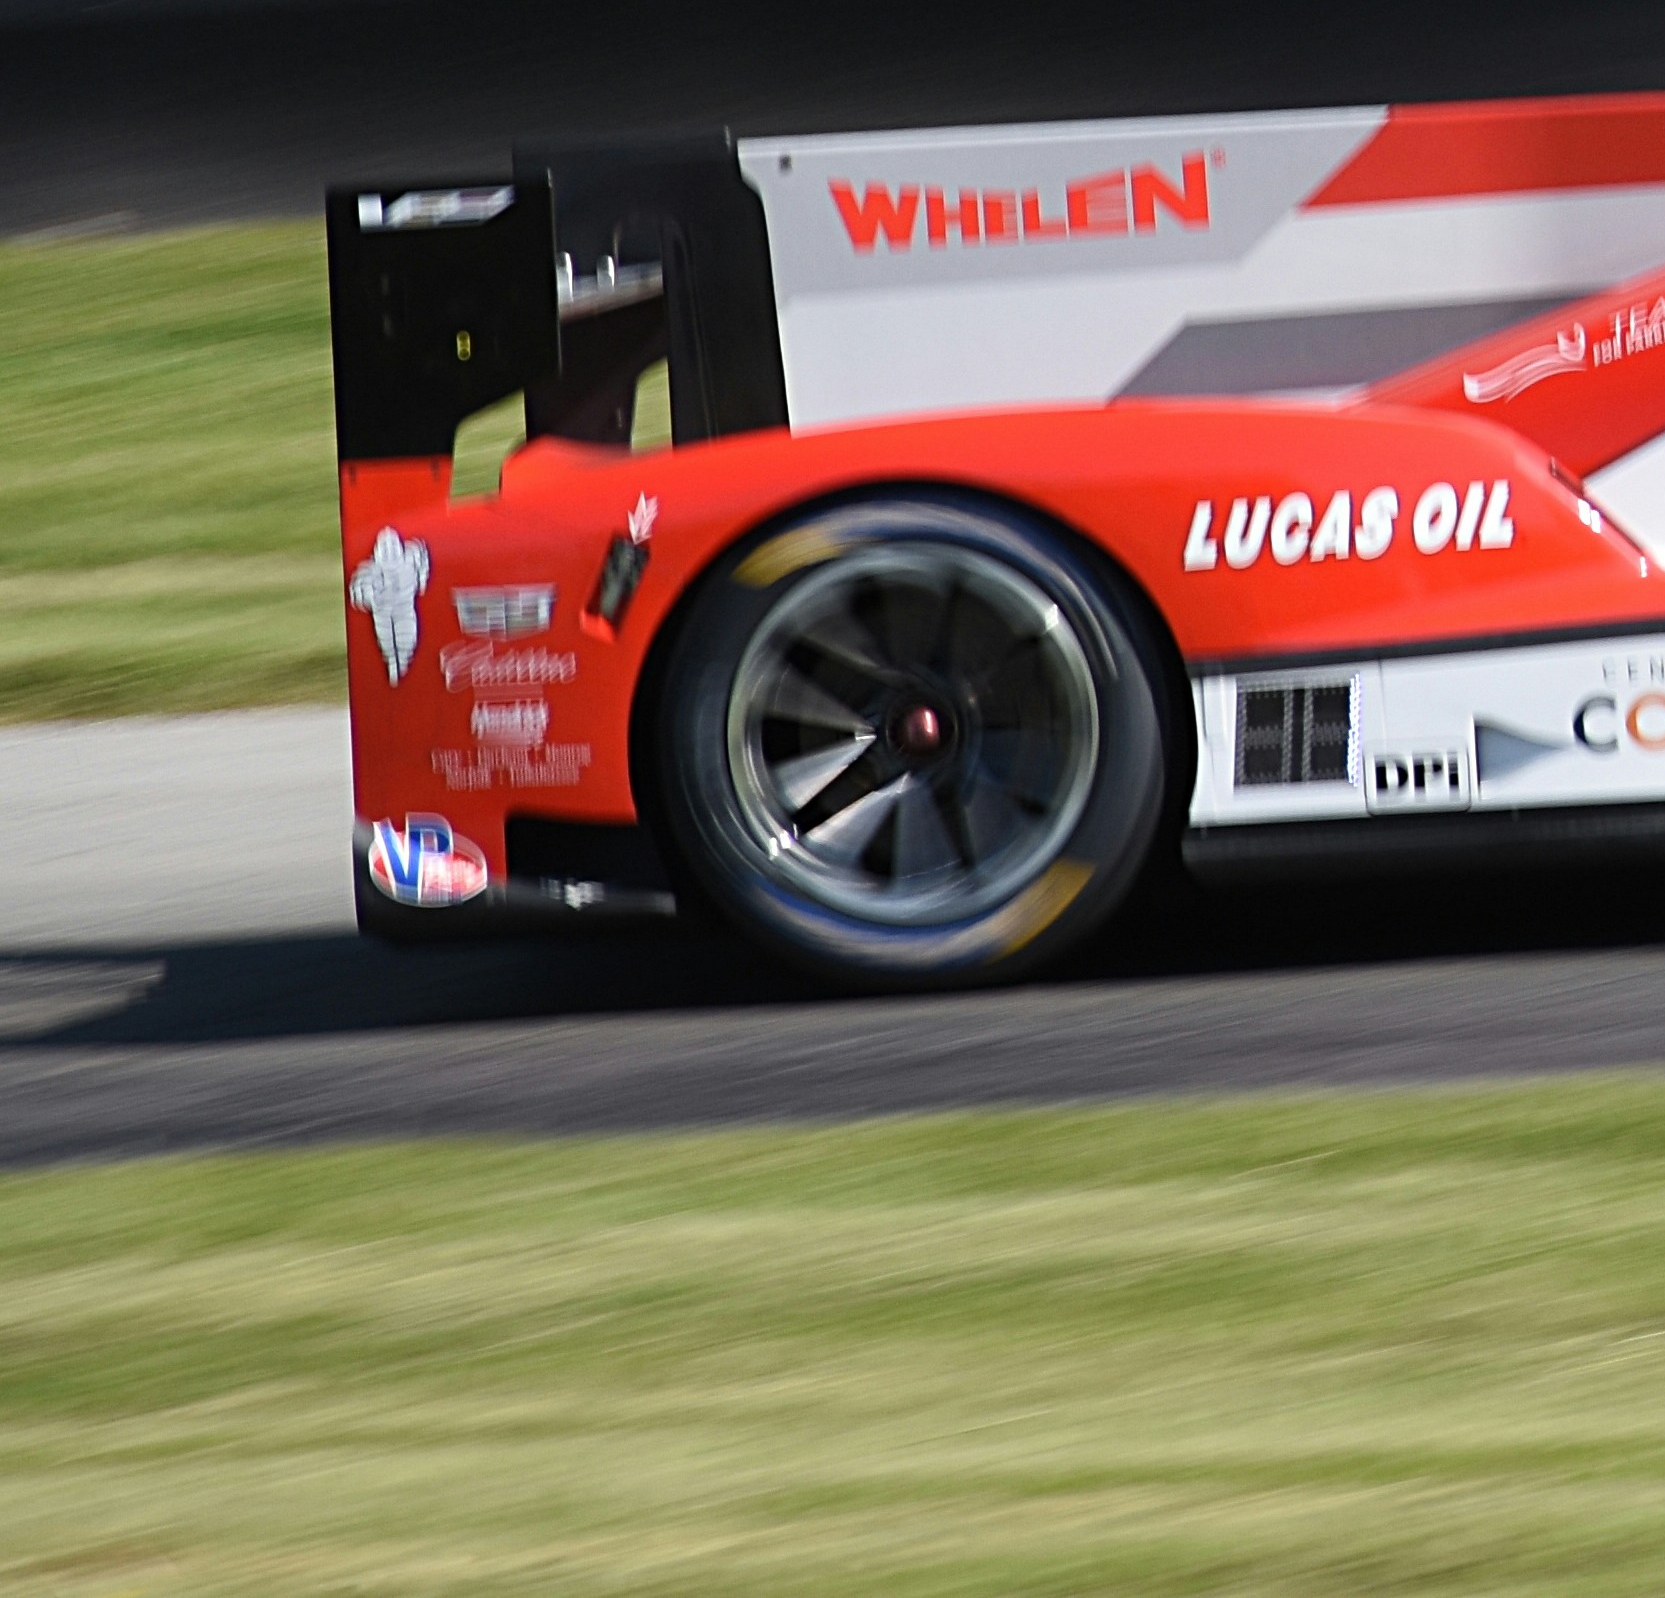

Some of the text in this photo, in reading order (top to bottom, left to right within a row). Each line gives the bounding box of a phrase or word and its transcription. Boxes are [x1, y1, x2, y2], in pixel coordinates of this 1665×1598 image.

[827, 149, 1212, 256] WHELEN
[1184, 480, 1515, 572] LUCAS OIL
[373, 812, 455, 904] VP
